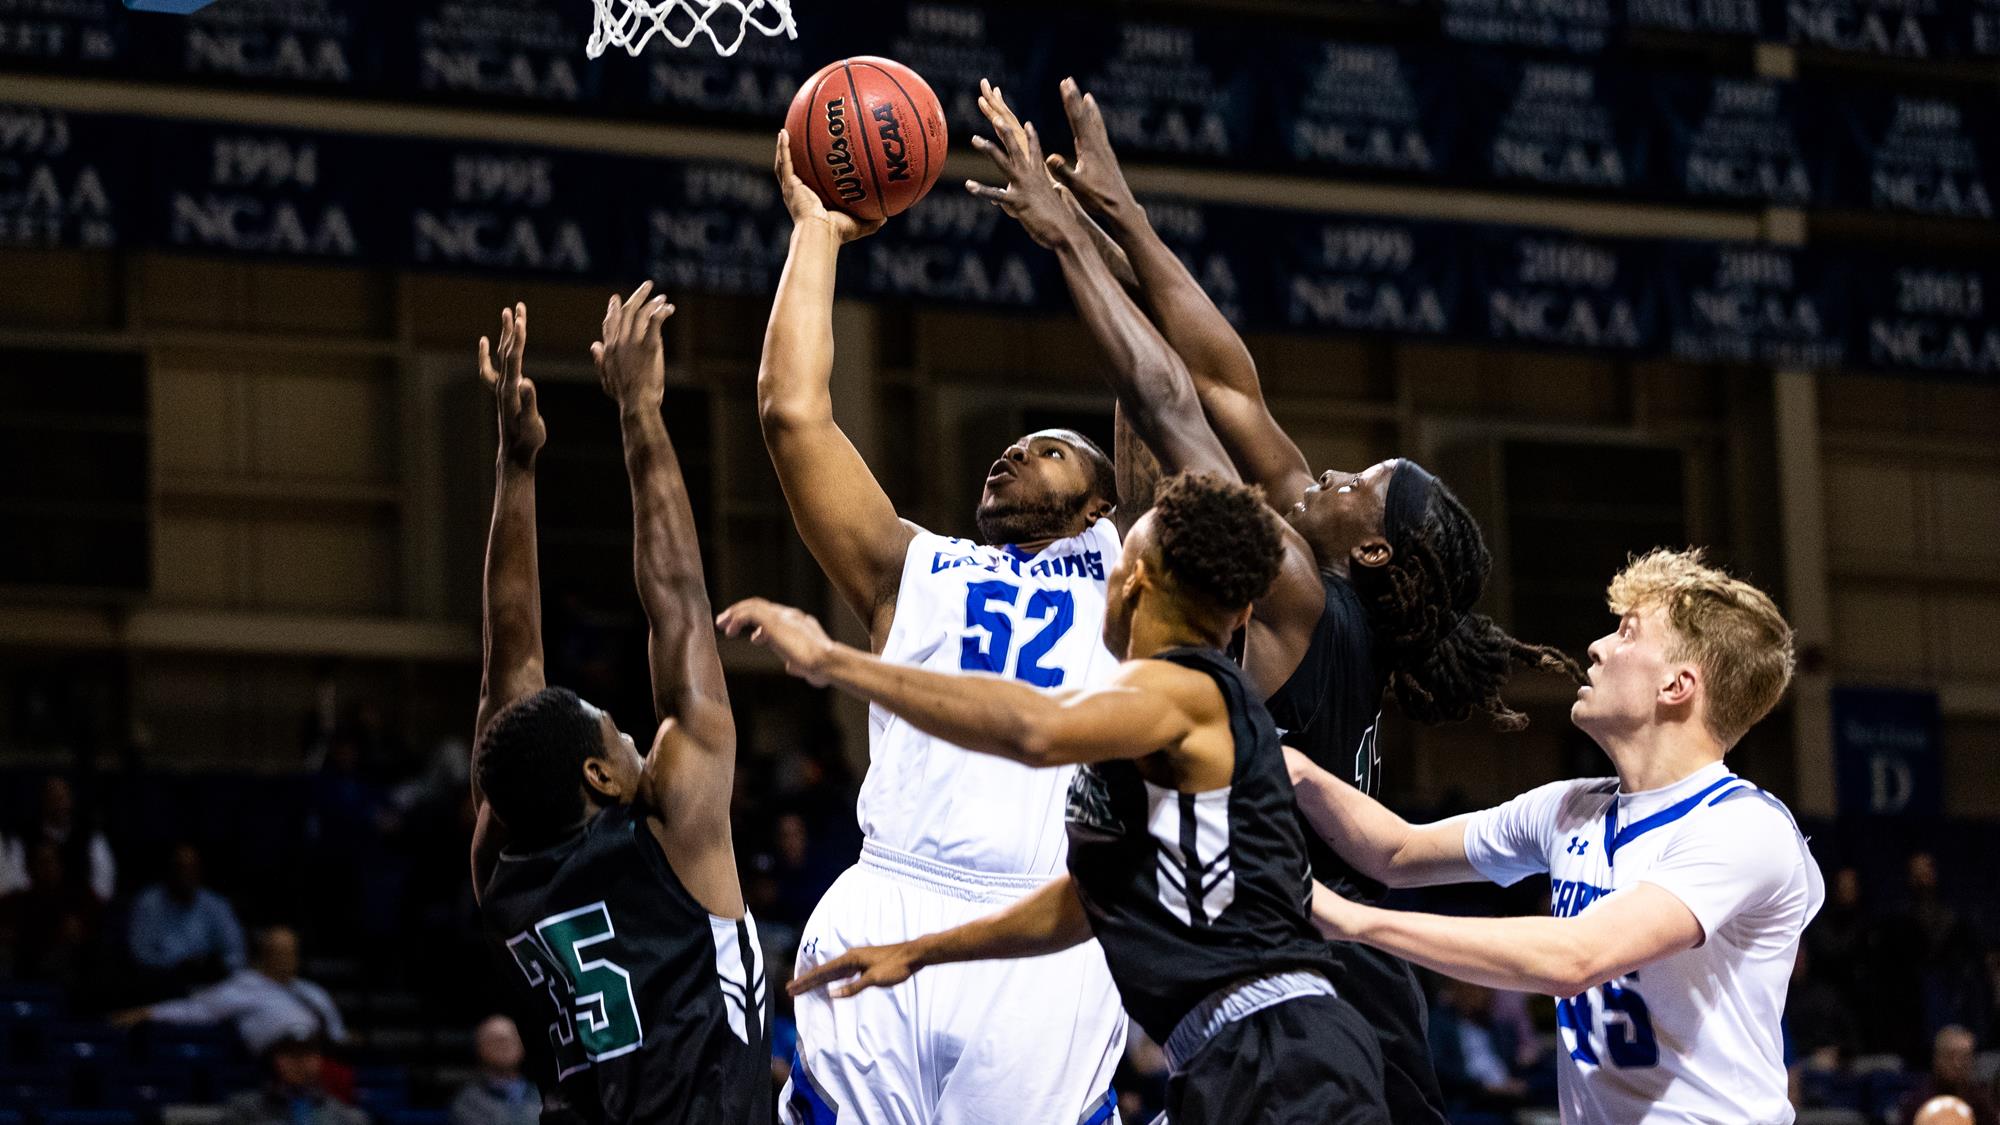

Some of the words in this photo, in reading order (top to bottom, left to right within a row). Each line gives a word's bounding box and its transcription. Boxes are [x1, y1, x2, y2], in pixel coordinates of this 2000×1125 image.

[187, 27, 350, 81] NCAA
[422, 46, 580, 100] NCAA
[651, 61, 797, 112] NCAA
[0, 108, 71, 154] 993
[825, 96, 867, 202] Wilson
[872, 102, 909, 184] NCAA
[1293, 117, 1434, 170] NCAA
[213, 137, 318, 187] 1994
[453, 155, 553, 206] 1995
[1493, 135, 1625, 186] NCAA
[1686, 150, 1812, 204] NCAA
[1871, 167, 1992, 219] NCAA
[172, 192, 357, 255] NCAA
[413, 210, 591, 272] NCAA
[868, 244, 1035, 304] NCAA
[1289, 274, 1448, 333] NCAA
[1488, 288, 1641, 347] NCAA
[1691, 288, 1823, 338] NCAA
[1869, 317, 2000, 372] NCAA
[959, 578, 1076, 690] 52
[1869, 750, 1914, 813] D
